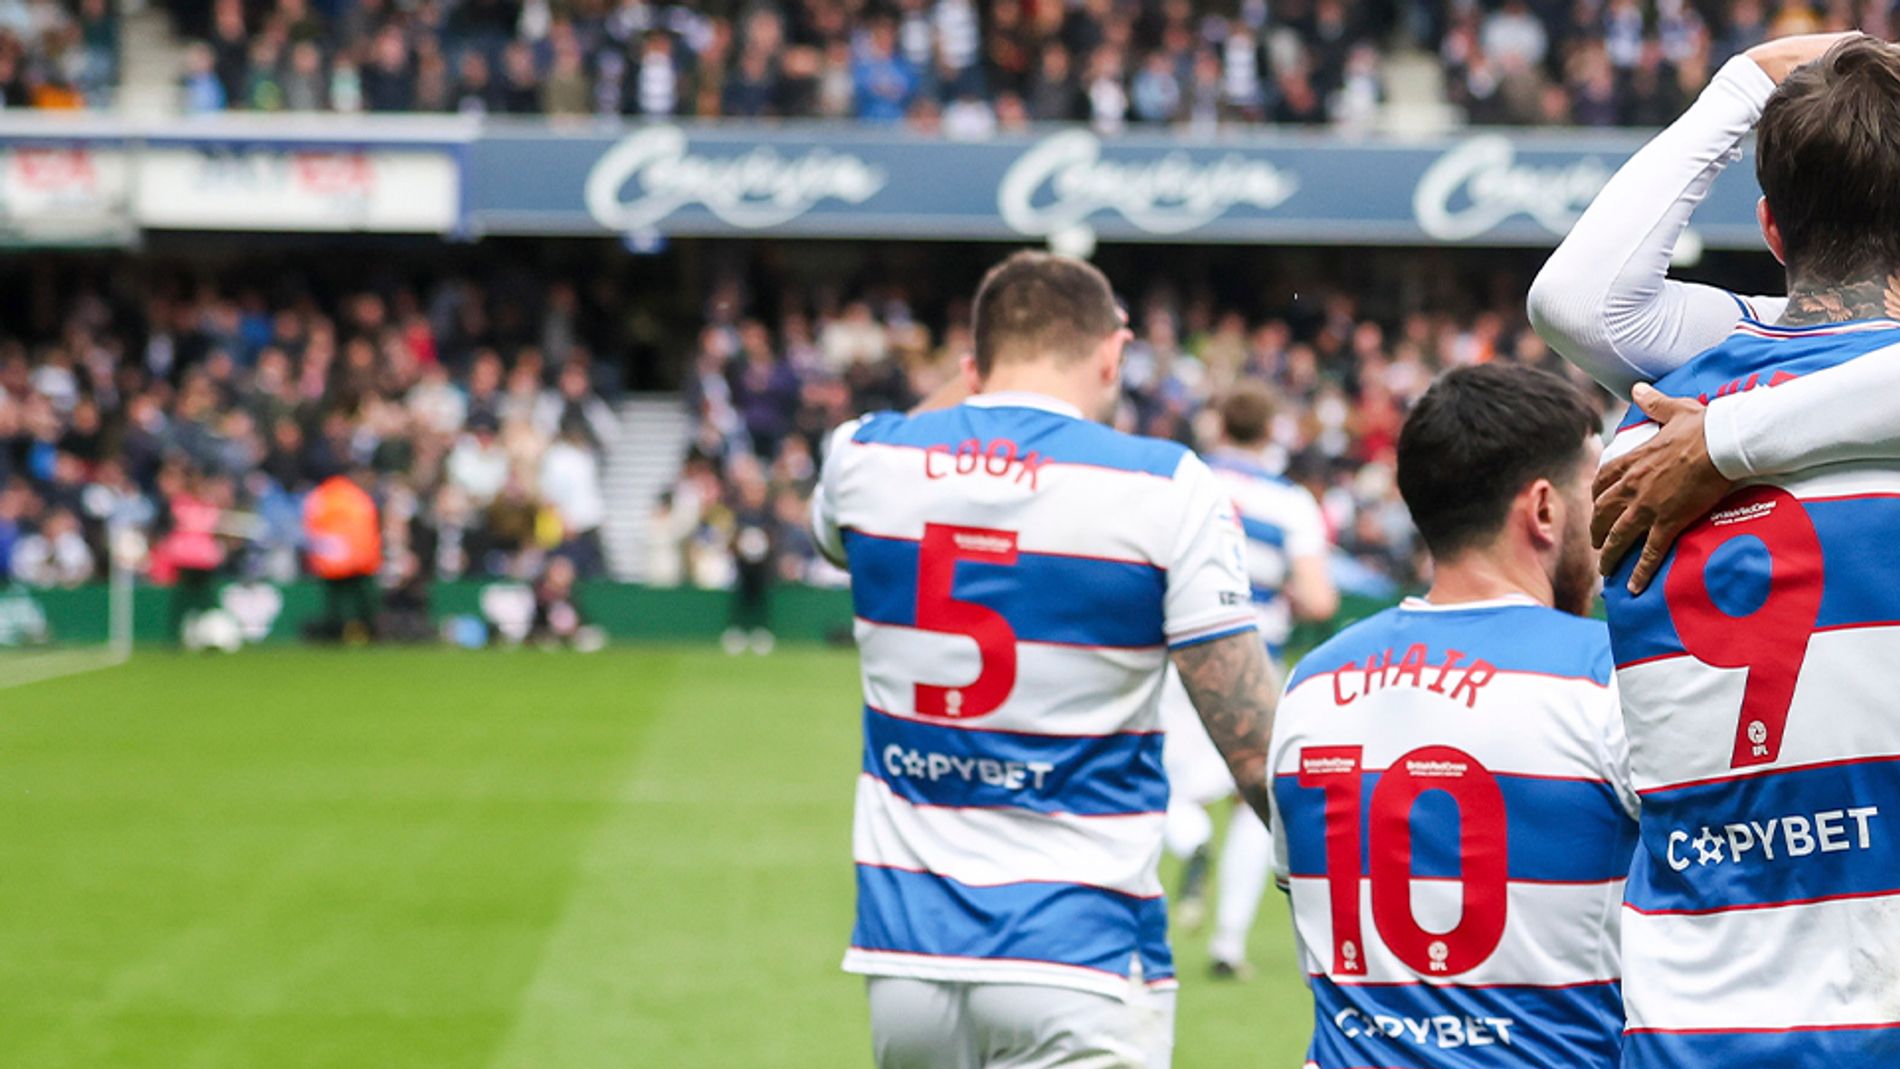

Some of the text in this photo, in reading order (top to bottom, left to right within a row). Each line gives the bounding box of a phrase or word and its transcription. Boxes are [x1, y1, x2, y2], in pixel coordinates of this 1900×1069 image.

[925, 438, 1054, 490] COOK
[914, 522, 1018, 719] 5
[1333, 642, 1497, 708] CHAIR
[1664, 486, 1823, 769] 9
[1300, 745, 1508, 977] 10
